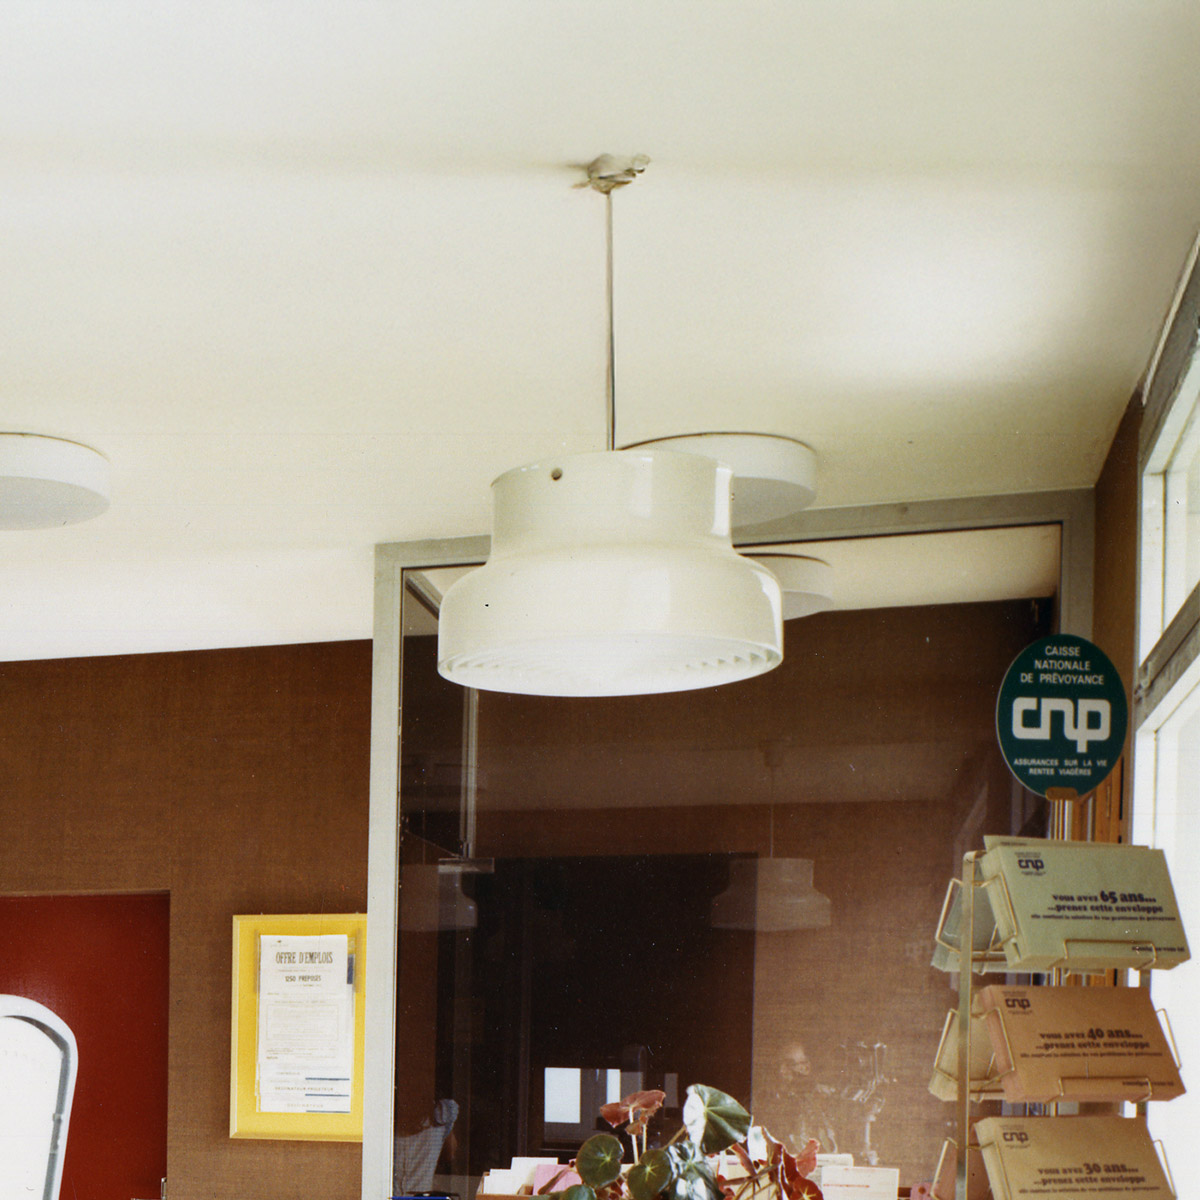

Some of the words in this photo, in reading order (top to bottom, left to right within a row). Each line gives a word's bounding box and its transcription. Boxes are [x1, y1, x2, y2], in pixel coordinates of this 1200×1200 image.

[1045, 645, 1080, 656] CAISSE
[1034, 660, 1091, 671] NATIONALE
[1020, 673, 1033, 683] DE
[1039, 672, 1104, 685] PRÉVOYANCE
[1012, 697, 1111, 753] cnp
[1014, 758, 1059, 767] ASSURANCES
[1064, 759, 1078, 767] SUR
[1018, 858, 1045, 871] cnp
[1100, 890, 1118, 903] 65
[1090, 904, 1113, 912] cette
[1115, 904, 1163, 914] enveloppe
[275, 951, 297, 964] OFFRE
[299, 951, 333, 964] D'EMPLOIS
[1005, 998, 1031, 1010] cnp
[1087, 1028, 1105, 1040] 40
[1078, 1041, 1101, 1049] cette
[1103, 1041, 1150, 1049] enveloppe
[1002, 1132, 1029, 1144] cnp
[1083, 1163, 1102, 1175] 30
[1075, 1176, 1098, 1184] cette
[1100, 1175, 1146, 1184] enveloppe
